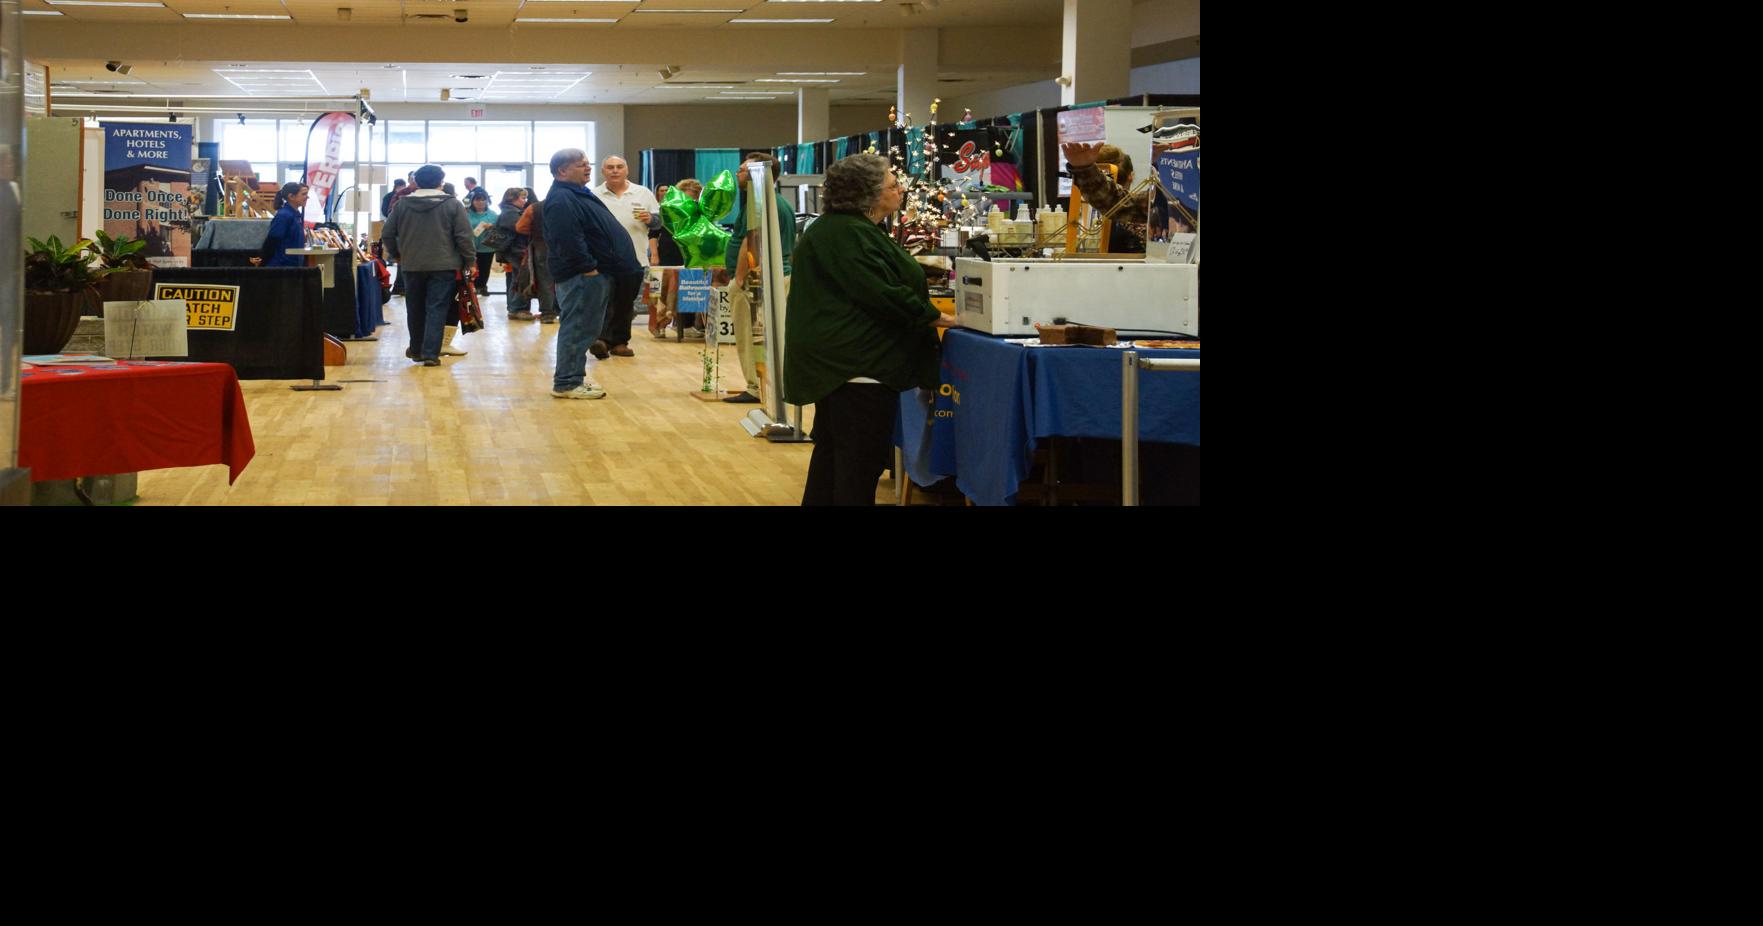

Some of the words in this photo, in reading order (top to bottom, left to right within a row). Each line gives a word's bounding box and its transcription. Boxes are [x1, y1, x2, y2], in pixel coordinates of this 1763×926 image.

[112, 129, 182, 140] APARTMENTS,
[126, 140, 166, 149] HOTELS
[126, 150, 135, 158] &
[137, 150, 169, 159] MORE
[105, 189, 142, 202] Done
[147, 190, 188, 204] Once,
[103, 207, 140, 220] Done
[145, 208, 188, 222] Right!
[161, 288, 232, 301] CAUTION
[186, 303, 220, 314] ATCH
[198, 315, 231, 326] STEP
